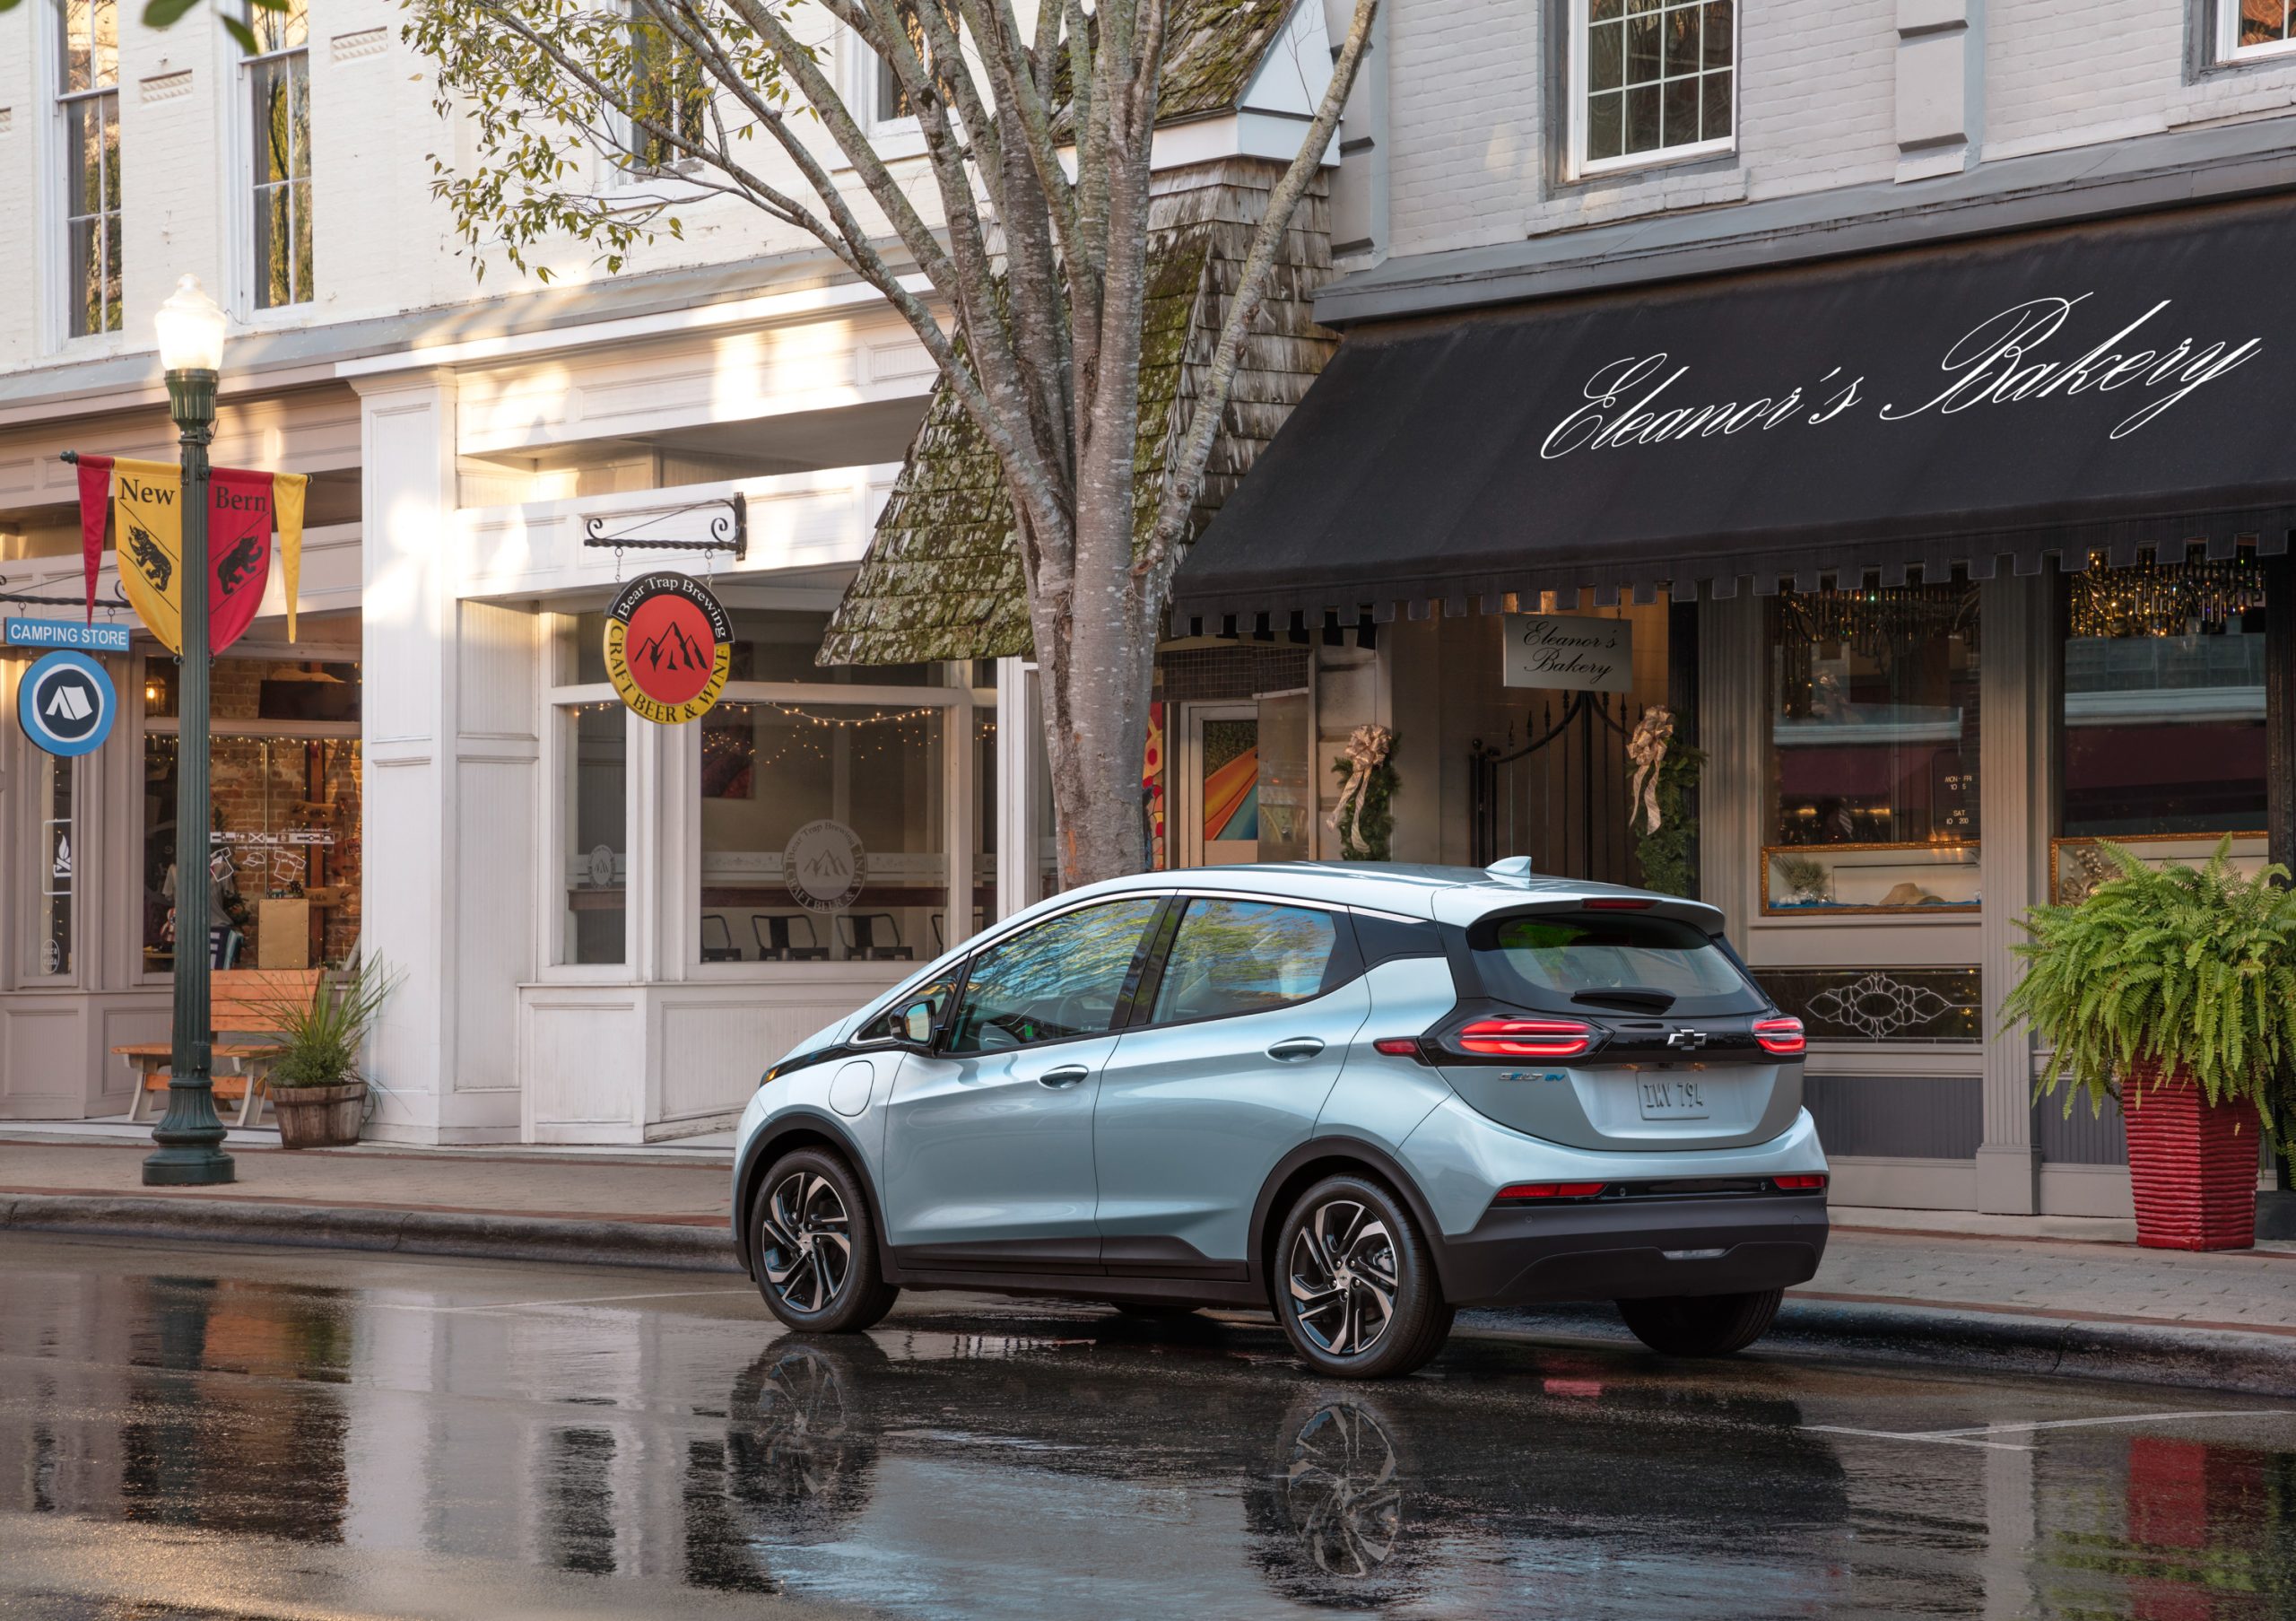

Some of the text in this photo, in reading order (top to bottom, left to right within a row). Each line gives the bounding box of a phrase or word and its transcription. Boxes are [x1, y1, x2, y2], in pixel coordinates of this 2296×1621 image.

[1540, 292, 2262, 459] Eleanor's Bakery
[119, 476, 267, 511] New Bern
[617, 576, 726, 639] Bear Trap Brewing
[11, 623, 127, 645] CAMPING STORE
[1524, 621, 1620, 649] Eleanor's
[609, 625, 729, 722] CRAFT BEER & WINE
[1523, 648, 1613, 684] Bakery
